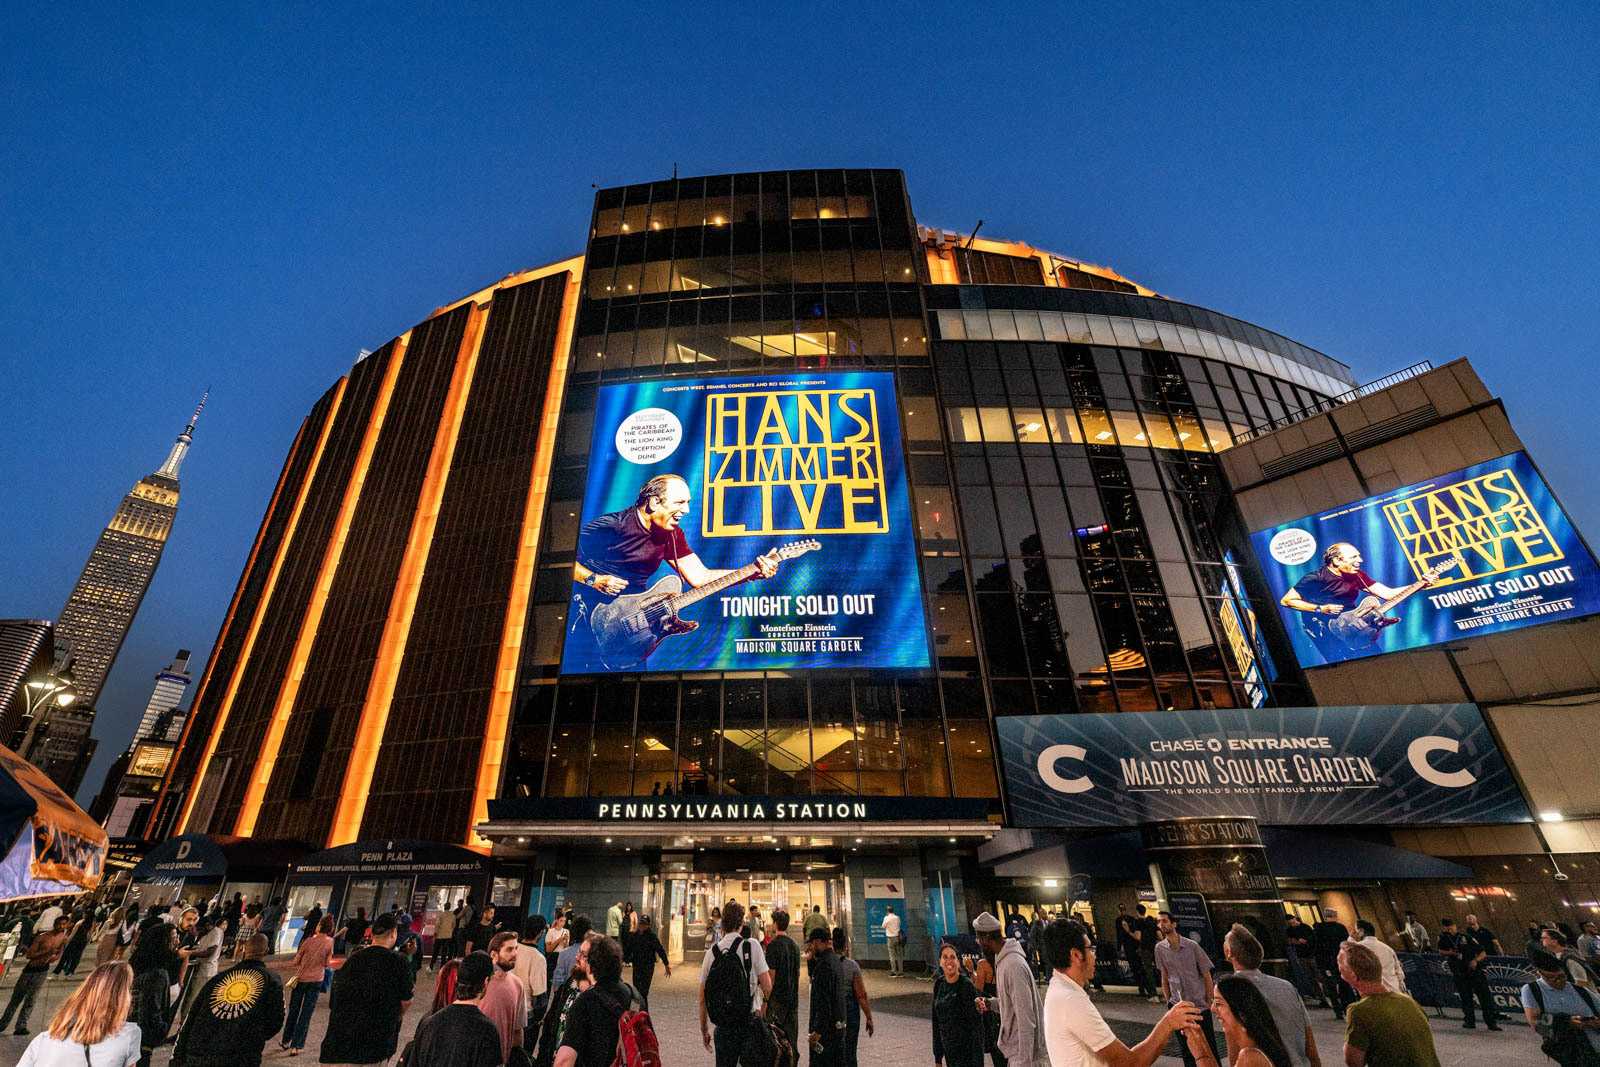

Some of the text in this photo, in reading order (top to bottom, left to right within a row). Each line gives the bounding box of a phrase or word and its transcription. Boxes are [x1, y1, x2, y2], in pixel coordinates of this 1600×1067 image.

[709, 389, 876, 448] HANS
[707, 445, 876, 483] ZIMMER
[704, 479, 885, 535] LIVE
[1386, 471, 1526, 540] HANS
[1400, 504, 1541, 561] ZIMMER
[1412, 526, 1561, 588] LIVE
[1428, 566, 1575, 610] TONIGHT SOLD OUT
[720, 594, 875, 617] TONIGHT SOLD OUT
[1472, 594, 1543, 614] Montefiore Einstein
[760, 623, 836, 632] Montefiore Einstein
[1457, 616, 1495, 630] MADISON
[1497, 609, 1532, 623] SQUARE
[736, 641, 776, 653] MADISON
[781, 641, 817, 653] SQUARE
[1150, 736, 1332, 752] CHASE ENTRANCE
[1037, 744, 1095, 794] C
[1119, 757, 1211, 786] MADISON
[1212, 755, 1293, 787] SQUARE
[1406, 735, 1477, 788] C
[1187, 787, 1231, 795] WORLD'S
[598, 803, 866, 818] PENNSYLVANIA STATION
[1200, 822, 1253, 840] STATION
[176, 840, 192, 860] D
[387, 841, 393, 850] 8
[175, 861, 204, 869] ENTRANCE
[361, 852, 413, 862] PENN PLAZA
[425, 863, 459, 871] DISABILITIES
